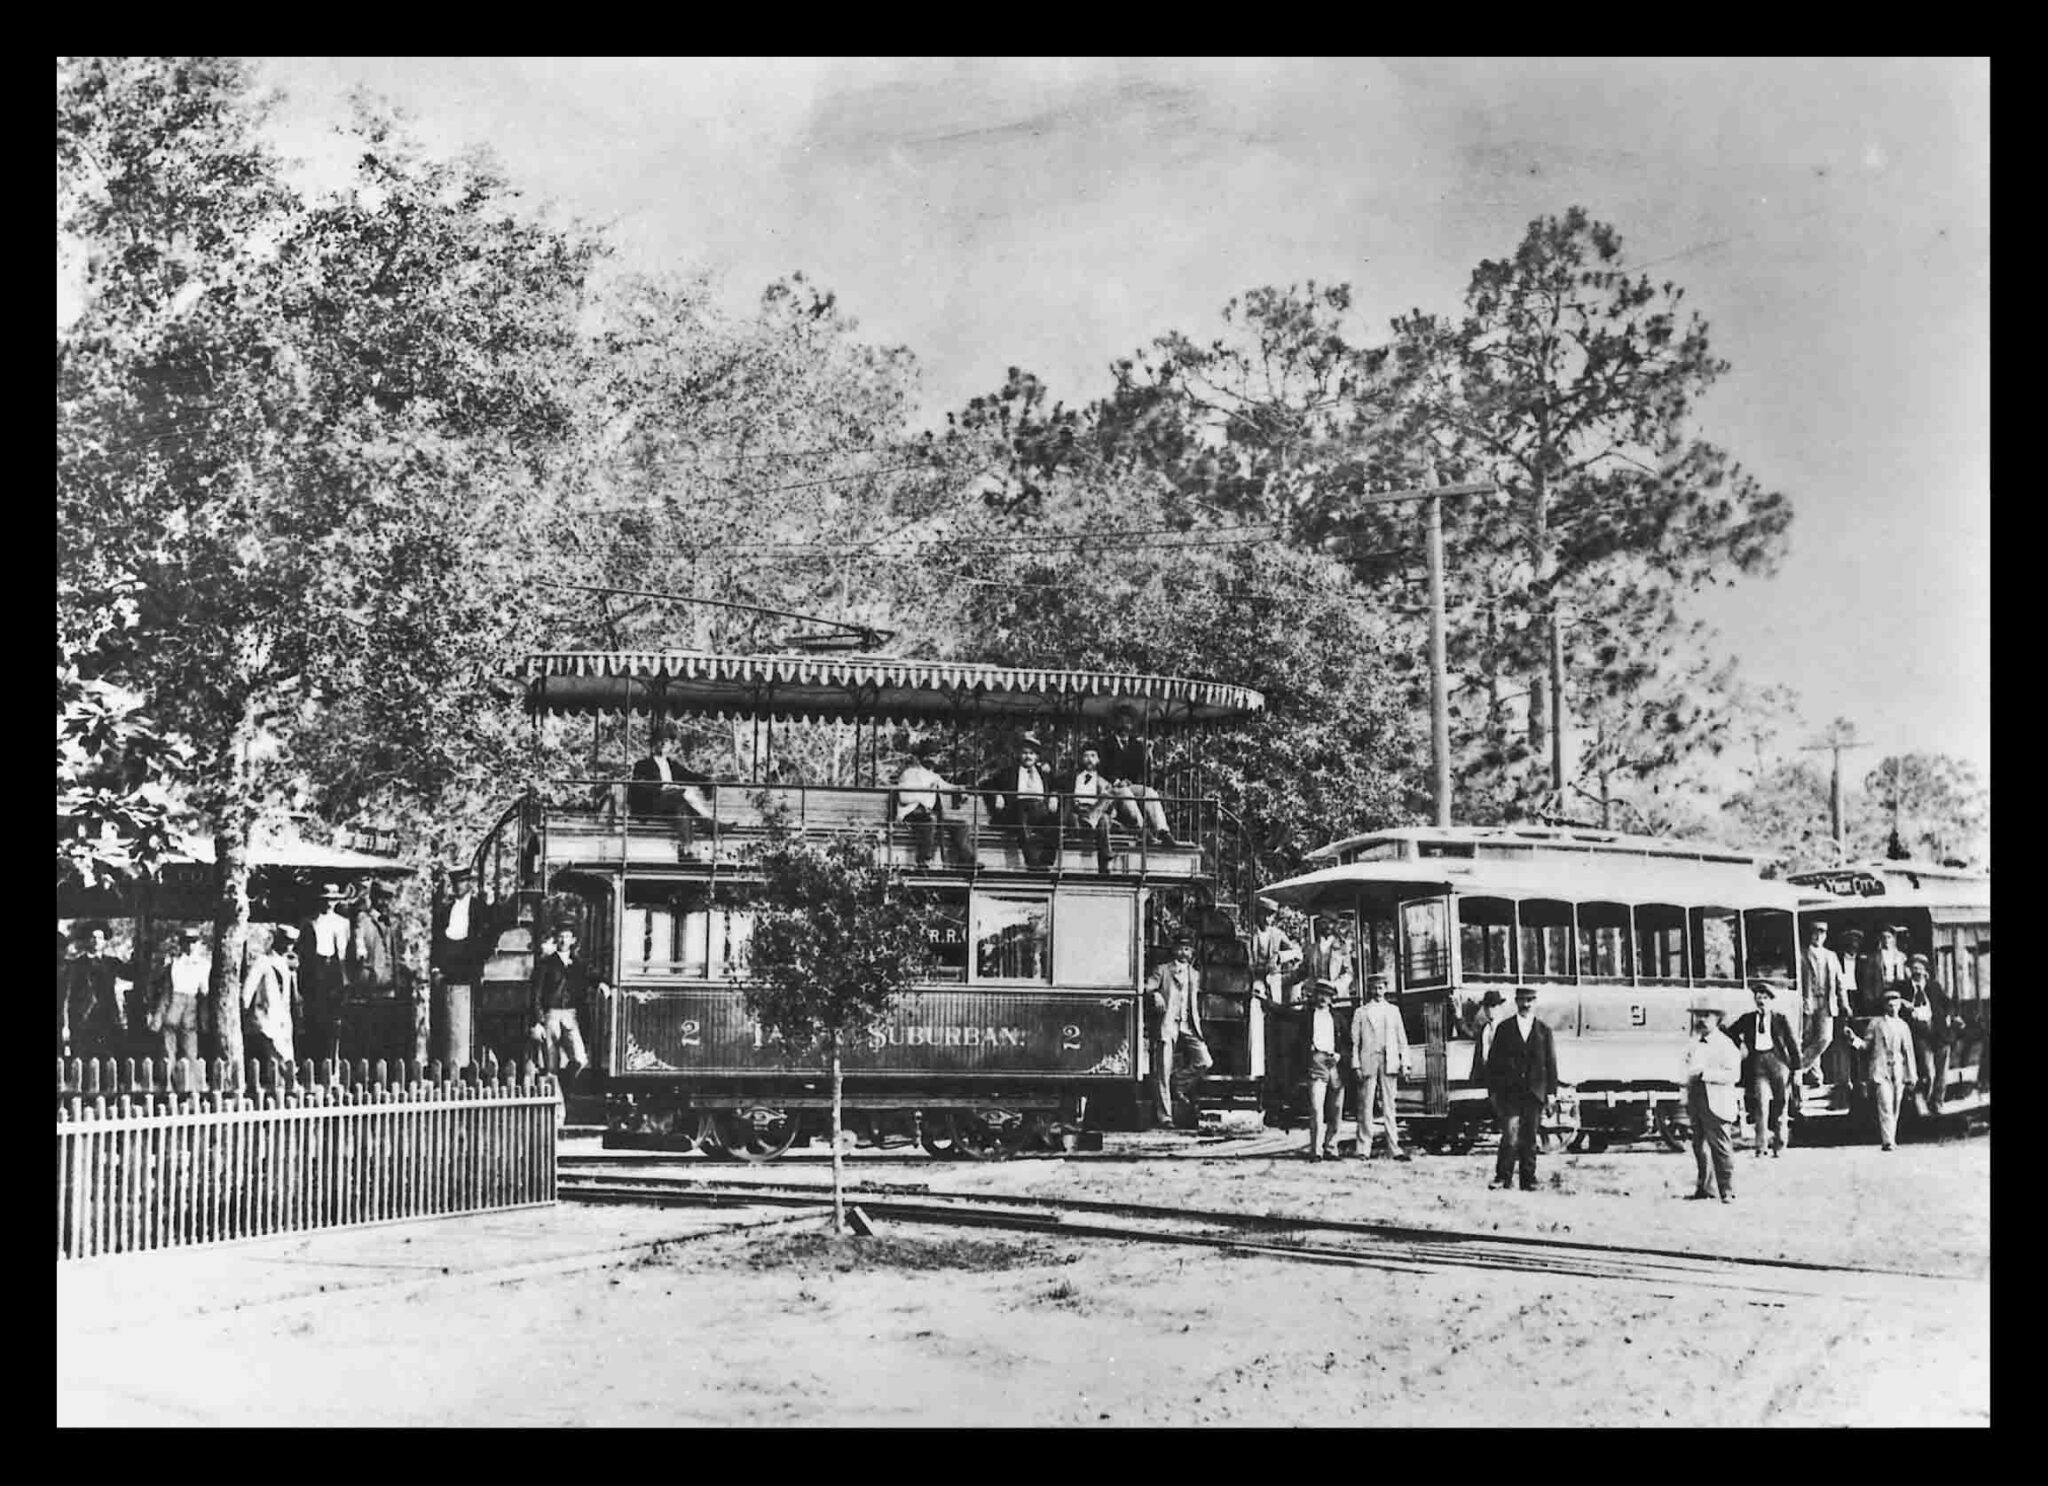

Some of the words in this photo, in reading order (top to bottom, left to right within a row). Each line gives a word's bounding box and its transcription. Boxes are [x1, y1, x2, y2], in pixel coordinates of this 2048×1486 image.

[680, 1020, 700, 1047] 2
[867, 1022, 1026, 1052] SUBURBAN.
[1062, 1024, 1082, 1050] 2
